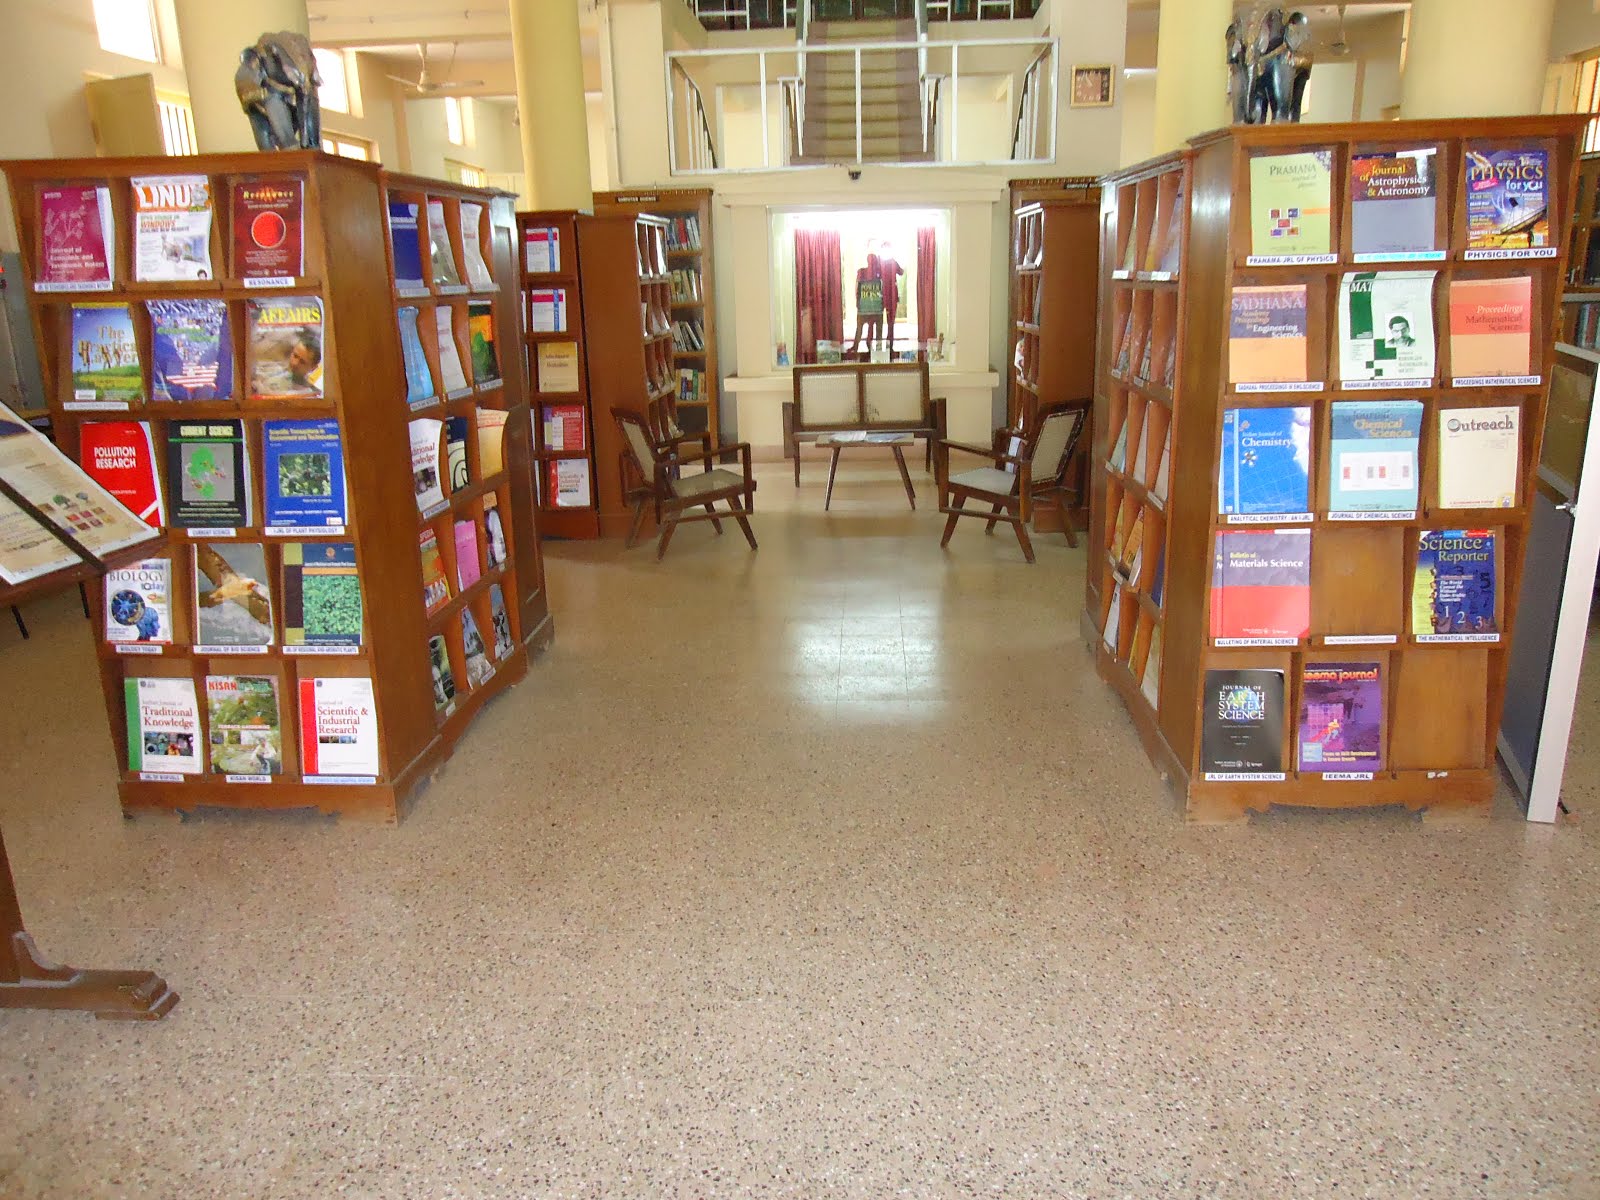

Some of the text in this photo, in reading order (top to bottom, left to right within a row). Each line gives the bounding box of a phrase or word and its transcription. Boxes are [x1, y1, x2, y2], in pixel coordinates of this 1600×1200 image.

[1372, 164, 1406, 175] Journal
[1471, 165, 1543, 180] PHYSICS
[1360, 172, 1427, 187] of Astrophysics
[1367, 186, 1430, 196] & Astronomy
[1506, 180, 1543, 191] for you
[248, 278, 288, 286] RESONANCE
[1231, 297, 1303, 311] SADHANA
[1477, 304, 1523, 314] Proceedings
[258, 307, 321, 324] AFFAIRS
[97, 325, 125, 339] The
[1253, 324, 1298, 333] Engineering
[1447, 415, 1514, 432] Outreach
[180, 425, 234, 437] CURRENT SCIENCE
[1241, 437, 1291, 448] Chemistry
[94, 447, 136, 458] POLLUTION
[96, 457, 137, 469] RESEARCH
[1419, 538, 1483, 551] Science
[1438, 551, 1489, 564] Reporter
[1230, 559, 1268, 568] Materials
[1270, 559, 1304, 567] Science
[110, 570, 163, 581] BIOLOGY
[141, 582, 164, 591] today
[1445, 605, 1449, 618] 1
[1457, 611, 1465, 624] 2
[1475, 615, 1483, 629] 3
[1338, 668, 1378, 684] journal
[208, 681, 237, 691] KISAN
[1219, 691, 1265, 701] EARTH
[317, 705, 369, 716] Scientific &
[1218, 700, 1265, 710] SYSTEM
[142, 705, 193, 717] Traditional
[1218, 710, 1265, 720] SCIENCE
[144, 717, 194, 730] Knowledge
[318, 716, 360, 725] Industrial
[318, 725, 358, 734] Research
